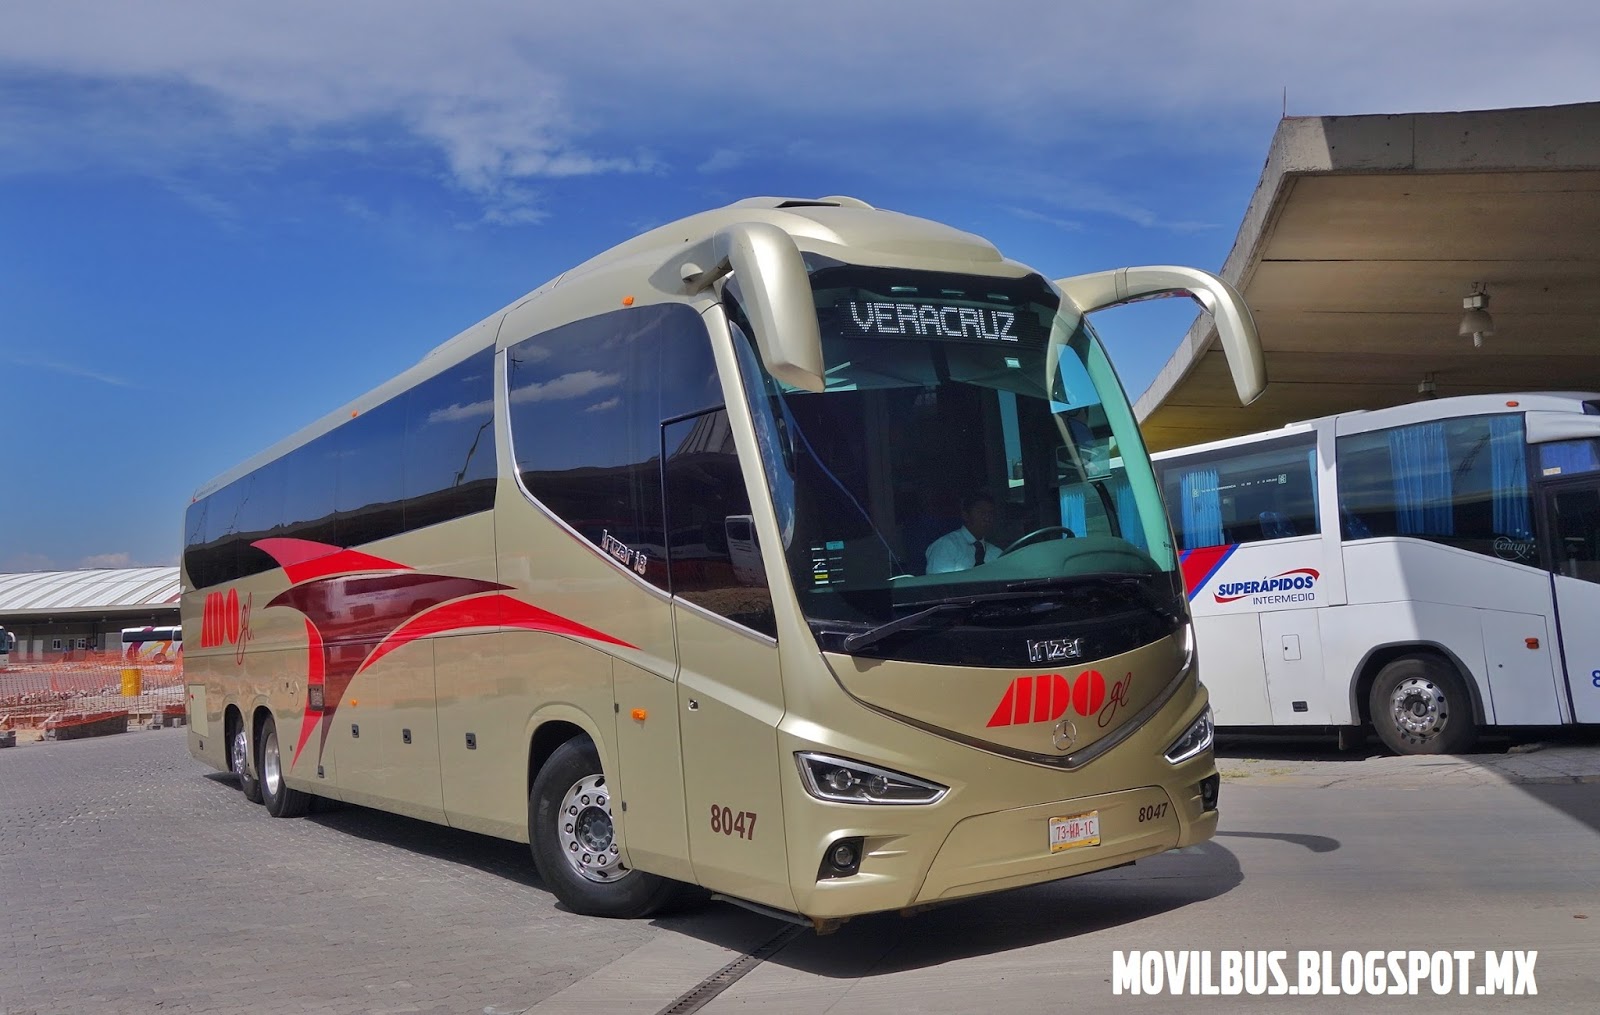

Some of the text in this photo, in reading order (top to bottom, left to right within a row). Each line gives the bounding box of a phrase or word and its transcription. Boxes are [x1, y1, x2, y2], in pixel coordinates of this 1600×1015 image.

[850, 302, 1018, 342] VERACRUZ
[1494, 540, 1530, 554] Century
[1218, 576, 1314, 596] SUPERÁPIDOS
[1253, 592, 1315, 605] INTERMEDIO
[986, 670, 1106, 727] ADO
[711, 804, 757, 840] 8047
[1138, 802, 1168, 822] 8047
